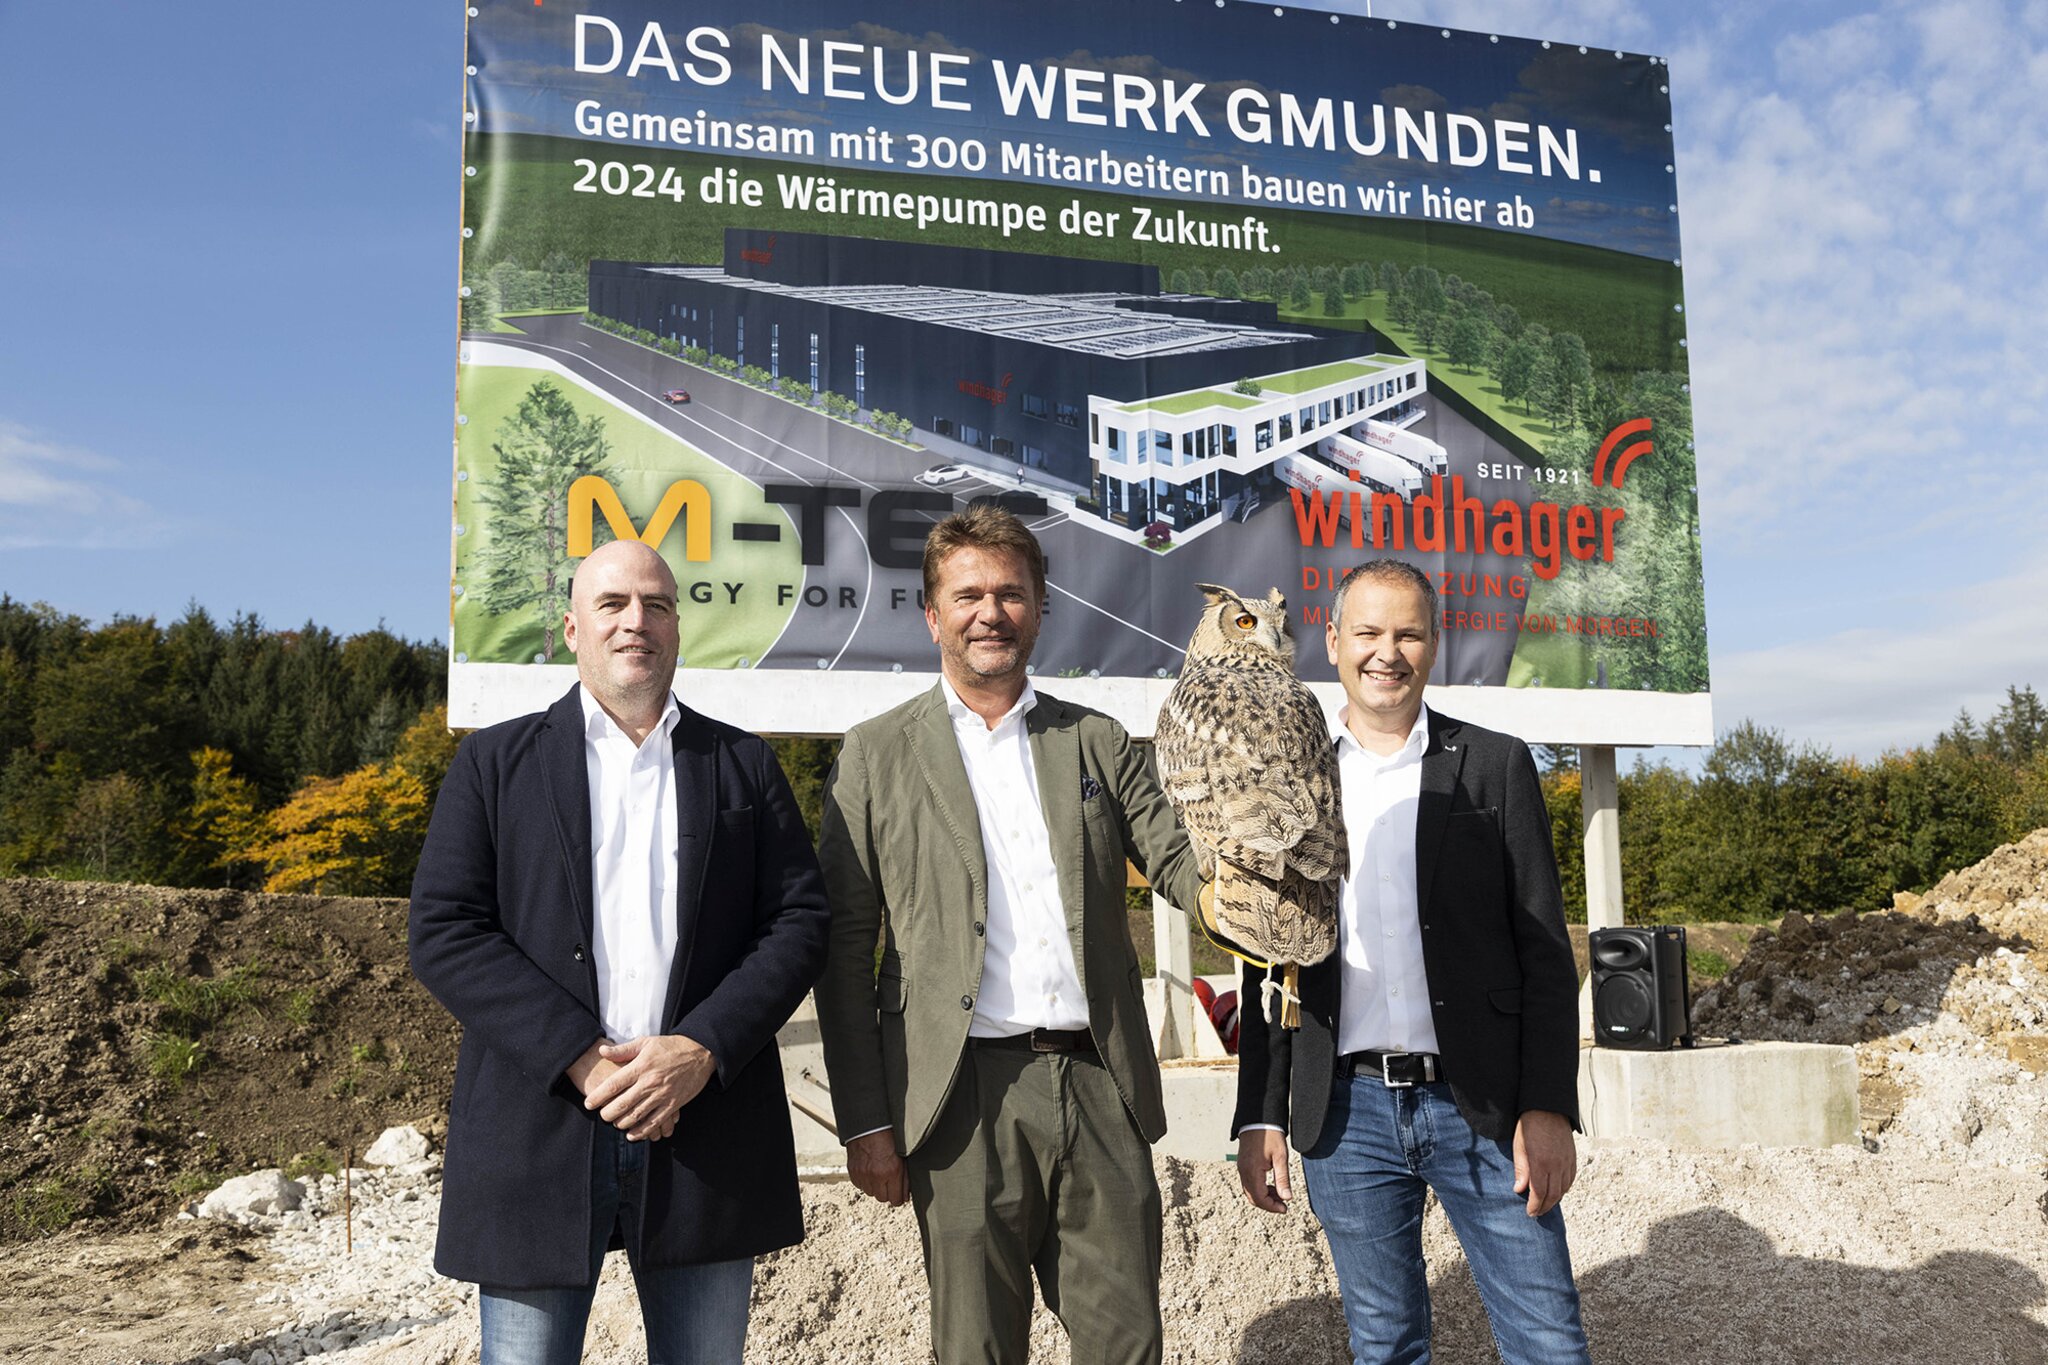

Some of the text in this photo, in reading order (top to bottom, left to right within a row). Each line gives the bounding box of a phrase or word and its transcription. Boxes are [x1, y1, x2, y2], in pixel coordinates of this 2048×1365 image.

[574, 14, 1602, 184] DAS NEUE WERK GMUNDEN.
[574, 99, 1535, 229] Gemeinsam mit 300 Mitarbeitern bauen wir hier ab
[573, 158, 1281, 254] 2024 die Wärmepumpe der Zukunft.
[1477, 462, 1580, 485] SEIT 1921
[1289, 470, 1625, 581] windhager
[778, 584, 857, 609] FOR
[1302, 566, 1353, 592] DI
[1303, 606, 1330, 626] MI
[1515, 614, 1557, 634] VON
